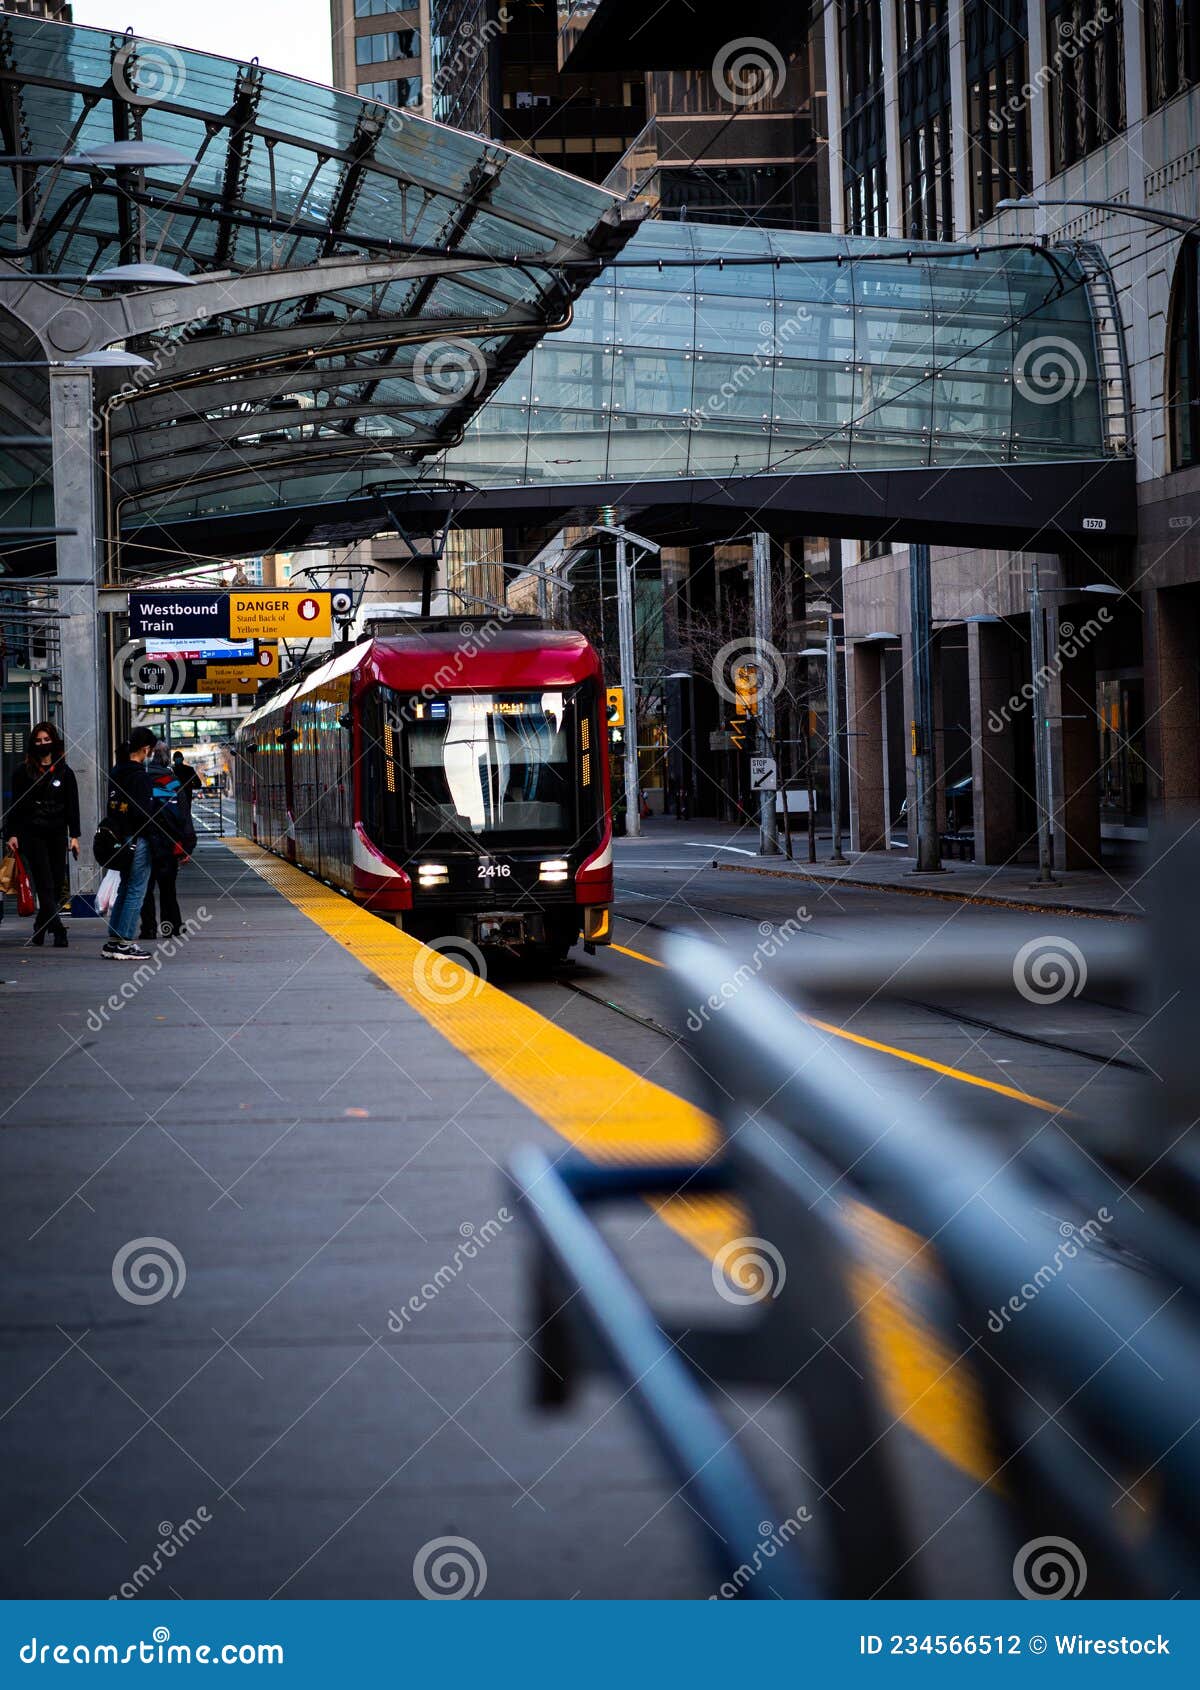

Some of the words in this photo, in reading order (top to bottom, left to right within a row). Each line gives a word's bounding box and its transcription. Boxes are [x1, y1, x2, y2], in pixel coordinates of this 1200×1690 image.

[1087, 520, 1103, 529] 1570
[139, 603, 218, 615] Westbound
[236, 601, 289, 611] DANGER
[236, 614, 257, 622] Stand
[258, 614, 277, 622] Back
[278, 614, 286, 622] of
[139, 620, 174, 632] Train
[237, 626, 260, 634] Yellow
[142, 667, 166, 675] Train
[477, 864, 511, 878] 2416
